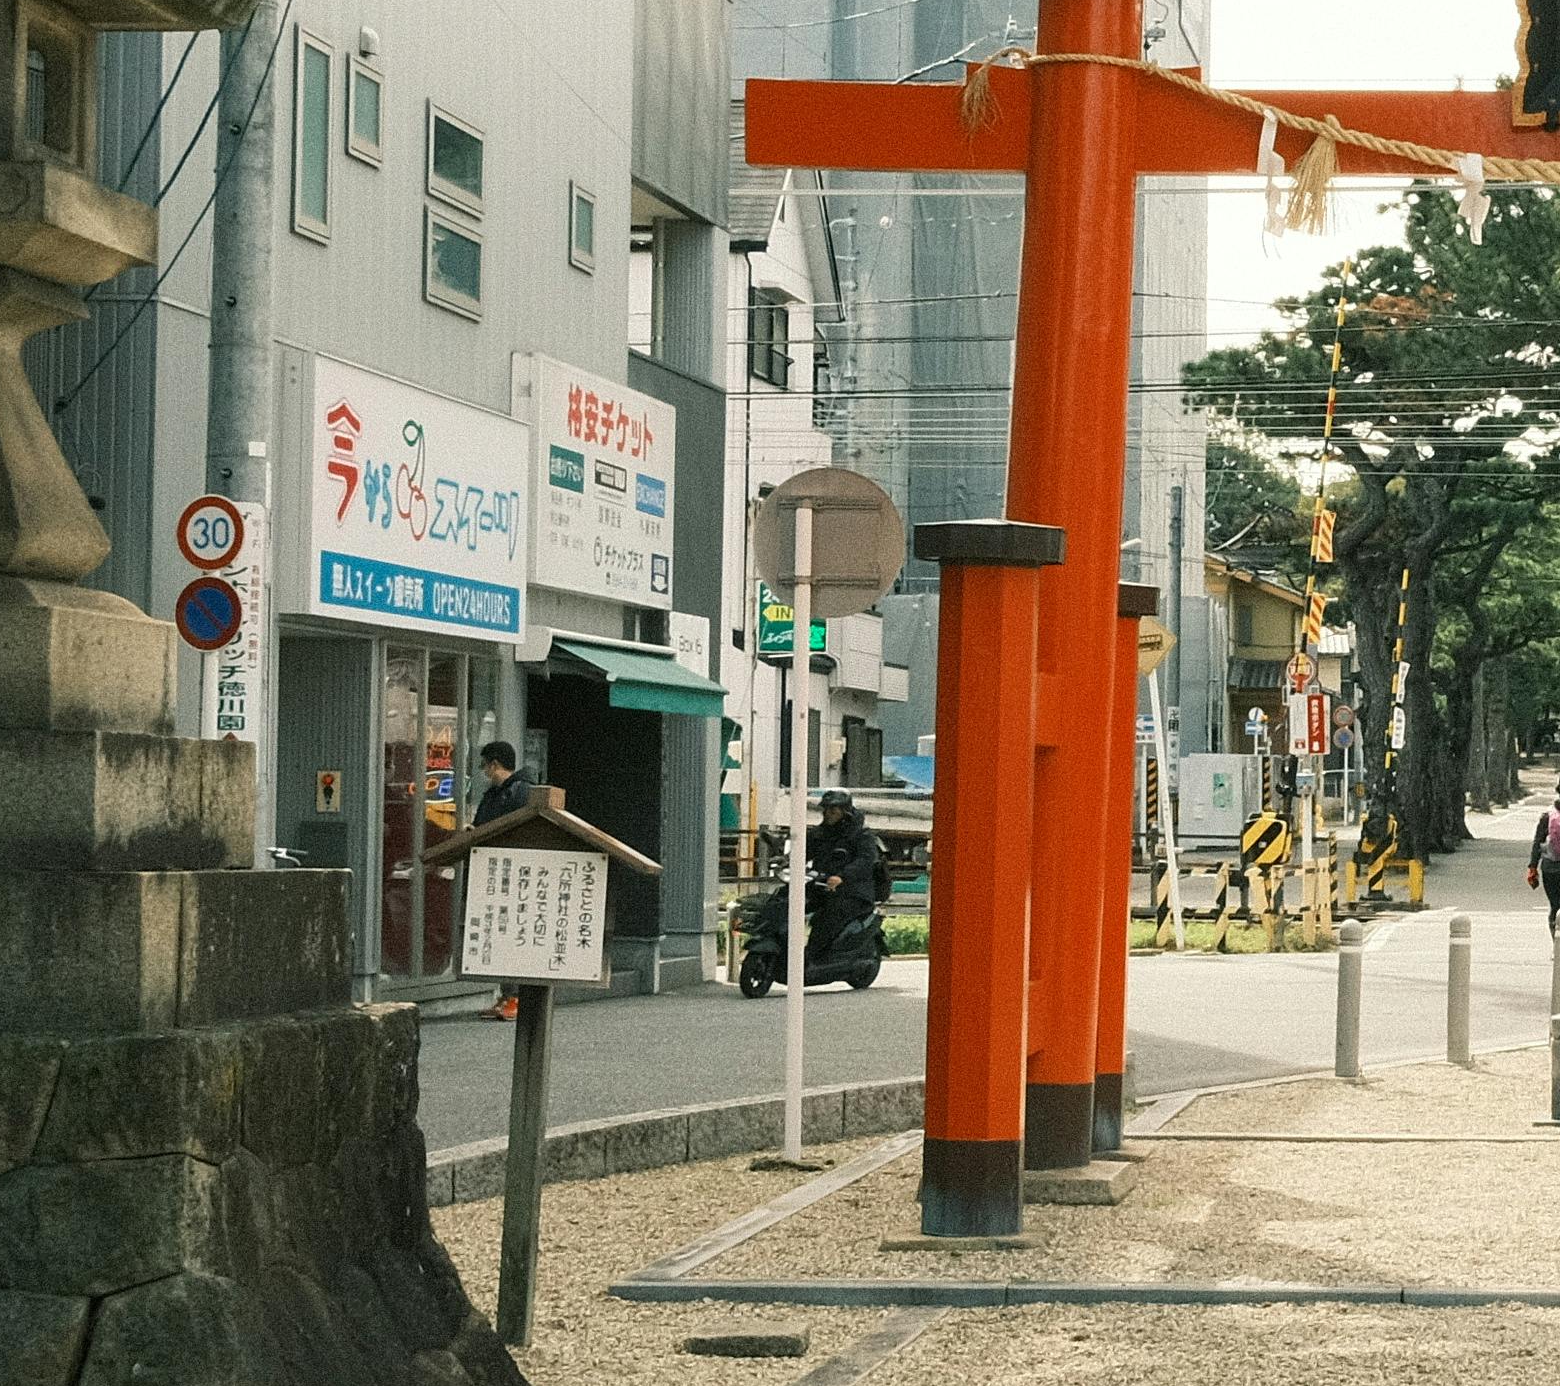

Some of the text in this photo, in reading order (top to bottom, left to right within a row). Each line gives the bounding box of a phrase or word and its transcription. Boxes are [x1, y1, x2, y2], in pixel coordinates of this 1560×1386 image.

[568, 381, 654, 462] 格安チケット
[327, 402, 391, 529] 今から
[429, 477, 519, 562] スイーツ
[193, 517, 230, 550] 30
[604, 544, 644, 572] チケットプラス
[432, 581, 511, 626] OPEN24HOURS
[775, 608, 791, 619] IN
[515, 866, 532, 947] 保存しましょう
[532, 867, 549, 947] みんなで大切に
[549, 861, 578, 972] 「六所神社の松並木」
[576, 861, 597, 949] ふるさとの名木
